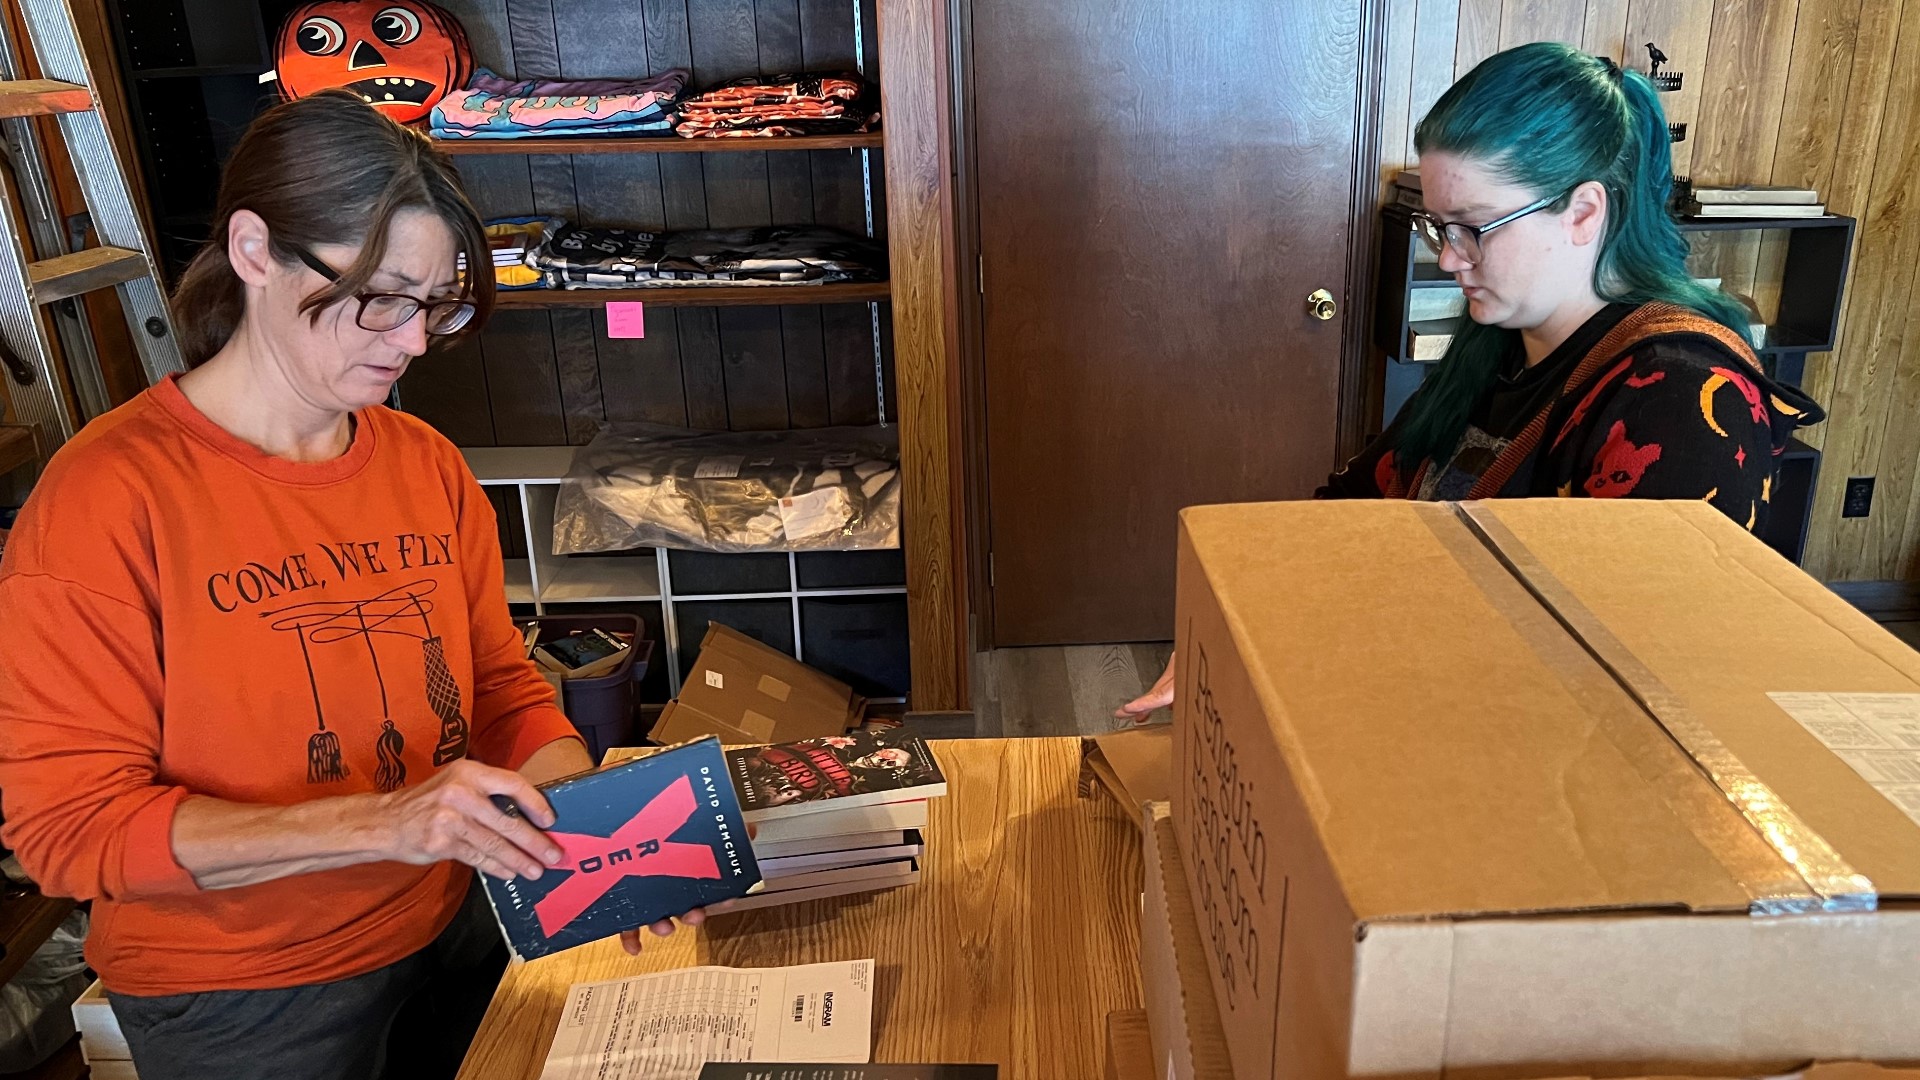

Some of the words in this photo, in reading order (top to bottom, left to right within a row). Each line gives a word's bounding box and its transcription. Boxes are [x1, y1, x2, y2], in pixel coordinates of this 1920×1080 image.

[207, 553, 326, 613] COME,
[316, 541, 388, 581] WE
[395, 533, 455, 570] FLY
[779, 759, 818, 789] BIRD
[805, 748, 851, 784] LITTLE
[1195, 641, 1265, 906] Penguin
[579, 838, 661, 874] RED
[700, 766, 720, 808] DAVID
[715, 814, 742, 876] DEMCHUK
[1193, 721, 1259, 1000] Random
[1191, 798, 1235, 1011] House
[822, 991, 833, 1026] INGRAM
